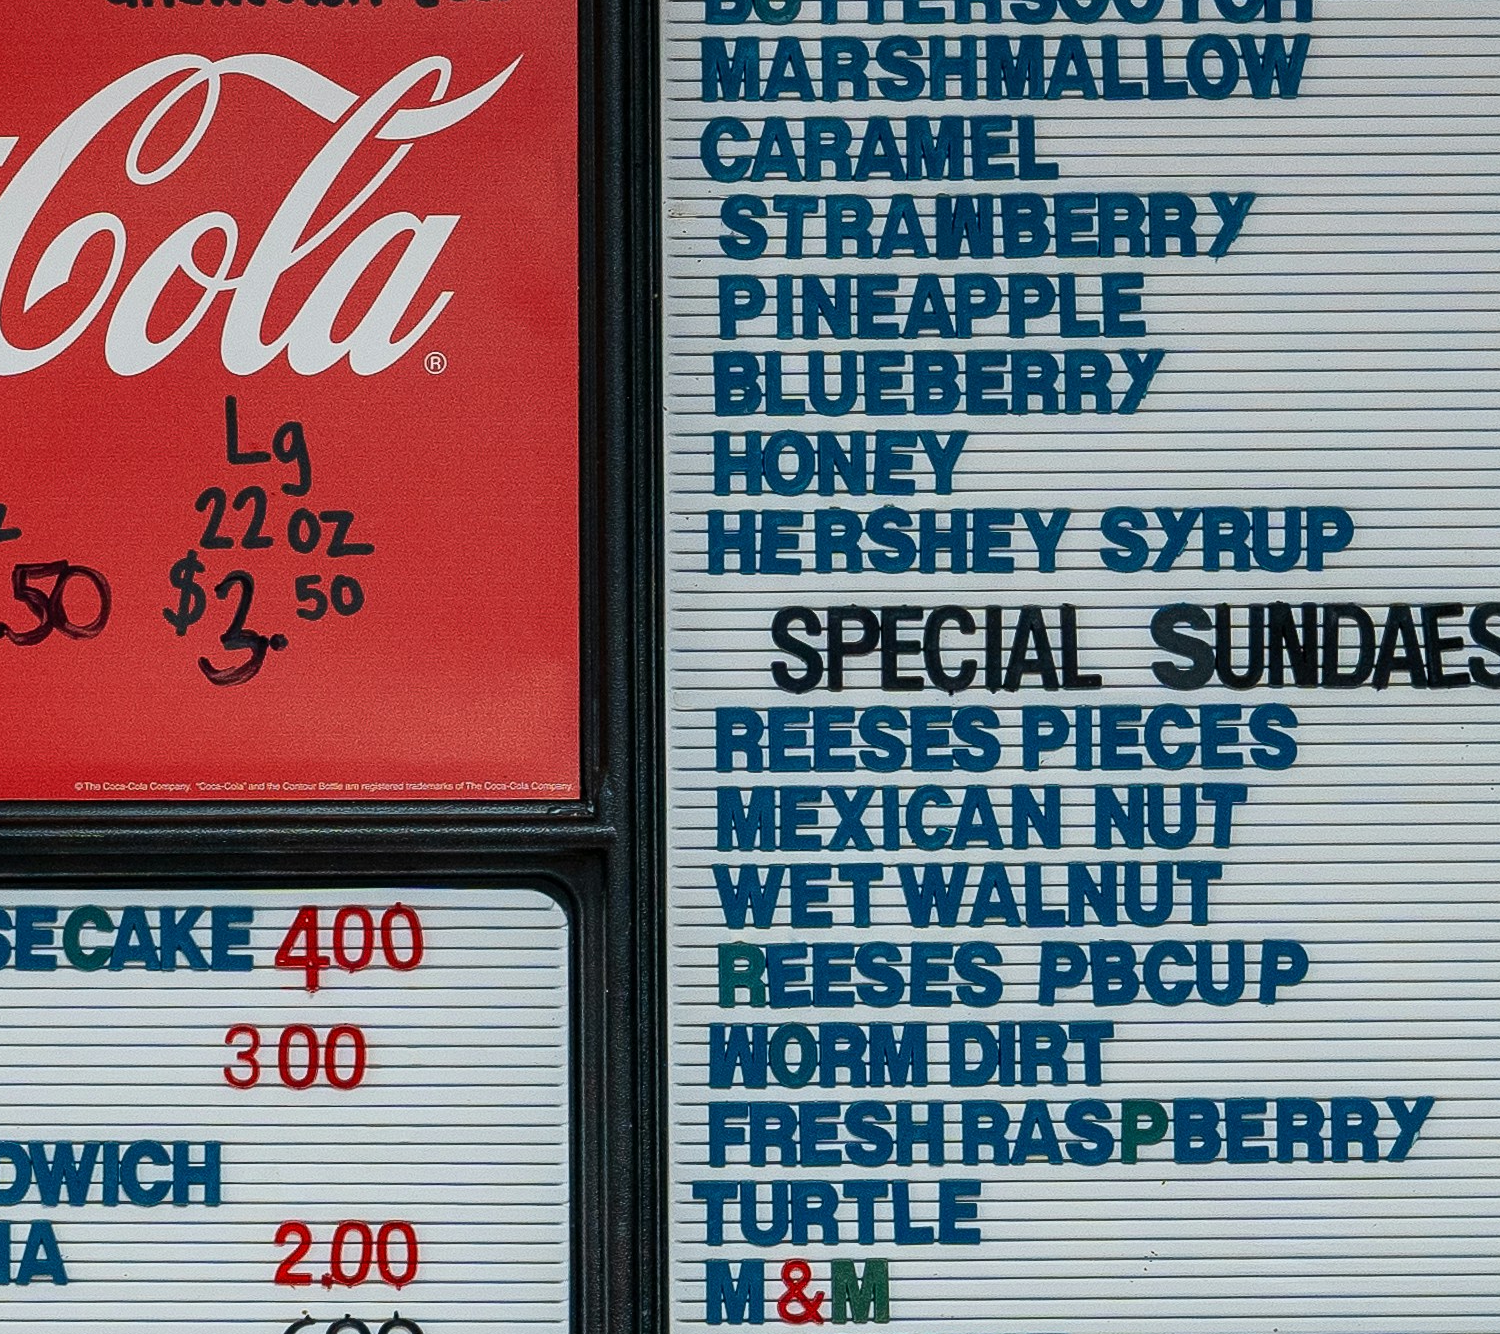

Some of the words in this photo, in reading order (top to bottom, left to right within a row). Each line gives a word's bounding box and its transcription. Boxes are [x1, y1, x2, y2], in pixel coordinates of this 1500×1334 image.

[699, 33, 1311, 103] MARSHMALLOW
[698, 115, 1059, 184] CARAMEL
[718, 192, 1257, 261] STRAWBERRY
[718, 272, 1146, 340] PINEAPPLE
[712, 349, 1166, 417] BLUEBERRY
[224, 395, 311, 497] Lg
[712, 430, 969, 496] HONEY
[706, 507, 1071, 575] HERSHEY
[1099, 505, 1354, 573] SYRUP
[770, 604, 1103, 695] SPECIAL
[715, 707, 1001, 773] REESES
[1021, 706, 1299, 771] PIECES
[715, 785, 1061, 853] MEXICAN
[1095, 784, 1248, 851] NUT
[711, 864, 884, 929] WET
[899, 863, 1224, 928] WALNUT
[274, 901, 424, 994] 400
[719, 941, 1002, 1009] REESES
[223, 1024, 366, 1091] 300
[708, 1022, 928, 1089] WORM
[949, 1021, 1115, 1087] DIRT
[707, 1099, 944, 1168] FRESH
[963, 1096, 1435, 1165] RASPBERRY
[692, 1181, 981, 1247] TURTLE
[273, 1221, 419, 1290] 2.00
